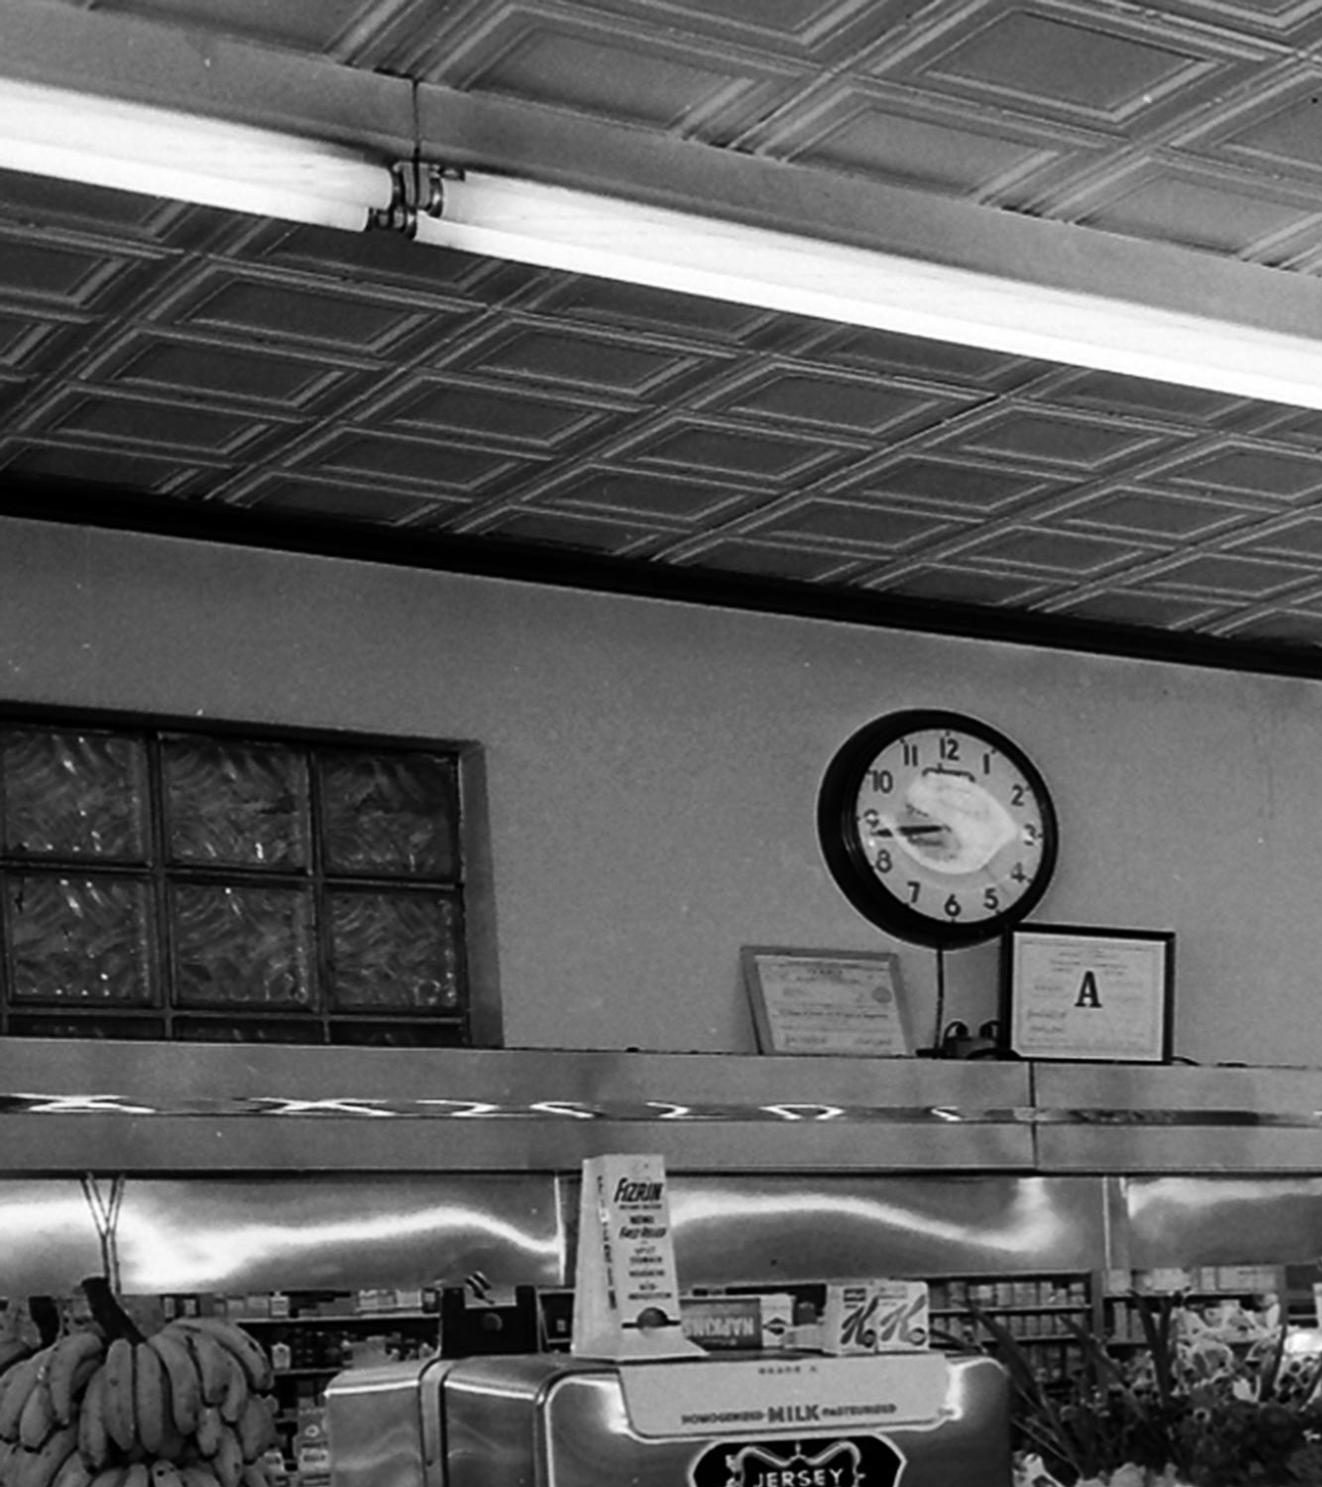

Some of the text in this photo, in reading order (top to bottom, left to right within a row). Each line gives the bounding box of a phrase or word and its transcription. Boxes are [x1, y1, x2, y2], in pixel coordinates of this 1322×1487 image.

[903, 743, 918, 767] 11
[939, 737, 960, 761] 12
[983, 753, 990, 775] 1
[872, 769, 893, 794] 10
[1011, 784, 1025, 806] 2
[863, 809, 879, 827] 9
[1024, 823, 1037, 846] 3
[876, 849, 892, 873] 8
[1011, 862, 1026, 883] 4
[907, 881, 921, 903] 7
[984, 888, 999, 910] 5
[944, 894, 961, 917] 6
[1073, 970, 1103, 1008] A
[767, 1404, 820, 1423] MILK
